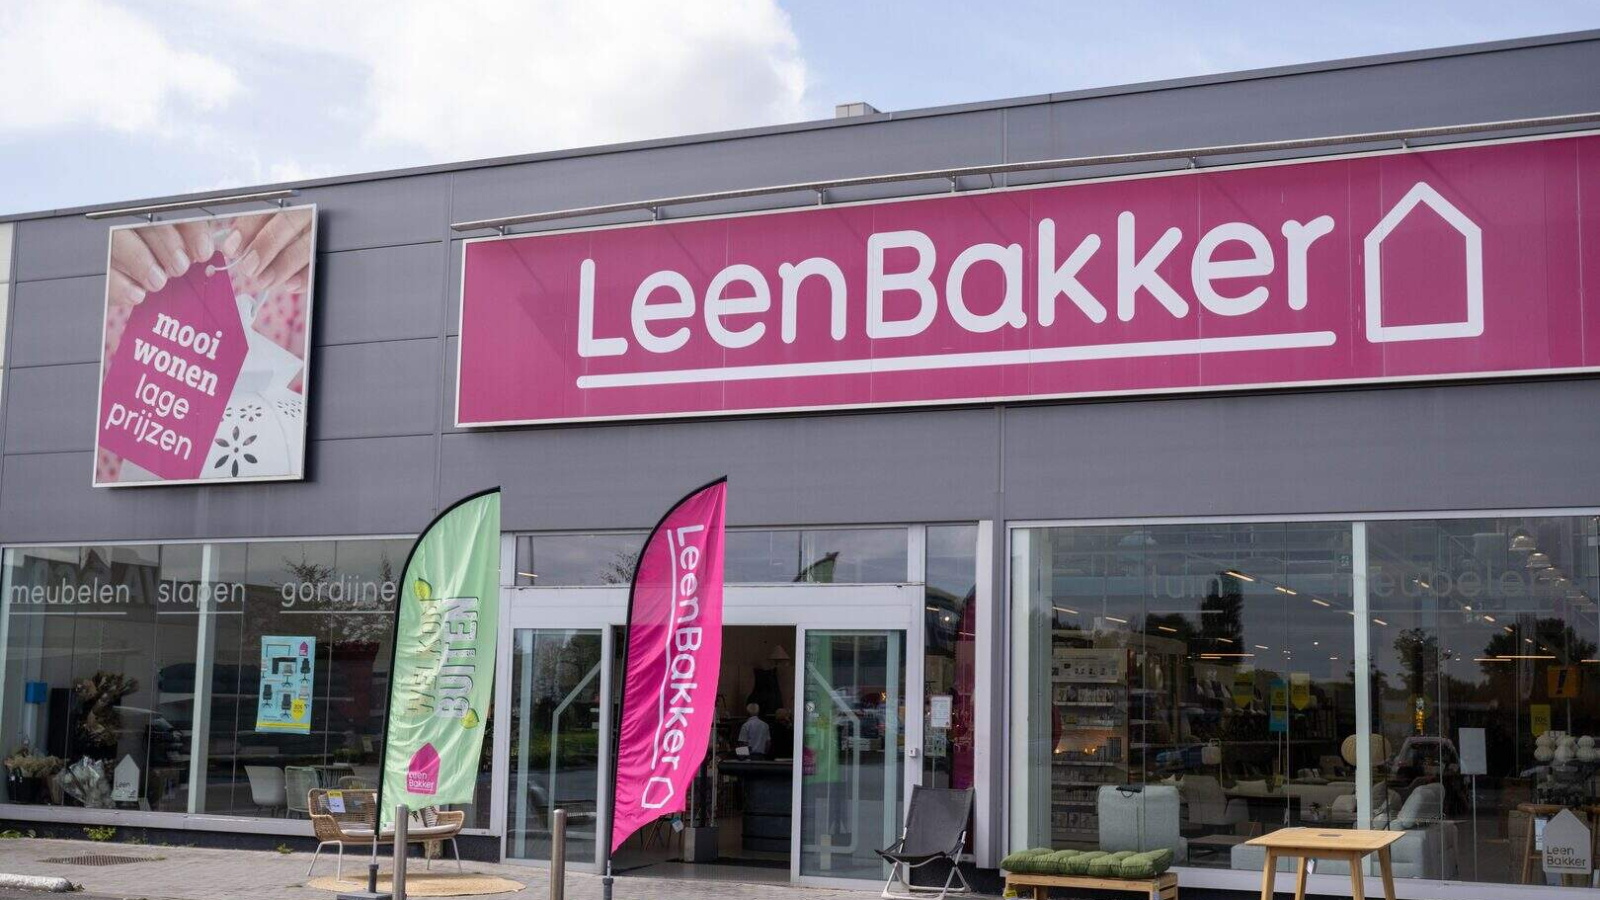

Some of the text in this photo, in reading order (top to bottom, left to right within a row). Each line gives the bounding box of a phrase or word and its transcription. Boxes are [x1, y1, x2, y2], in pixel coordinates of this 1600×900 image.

[577, 210, 1335, 358] LeenBakker
[152, 312, 223, 361] mooi
[133, 338, 219, 397] wonen
[135, 373, 190, 420] lage
[105, 402, 193, 461] prijzen
[10, 577, 130, 604] meubelen
[157, 577, 246, 608] slapen
[281, 573, 397, 607] gordijne
[1152, 564, 1223, 599] tuin
[437, 597, 479, 718] BUITEN
[661, 524, 705, 771] LeenBakker
[409, 779, 435, 789] Bakker
[1546, 845, 1575, 855] Leen
[1546, 855, 1587, 867] Bakker
